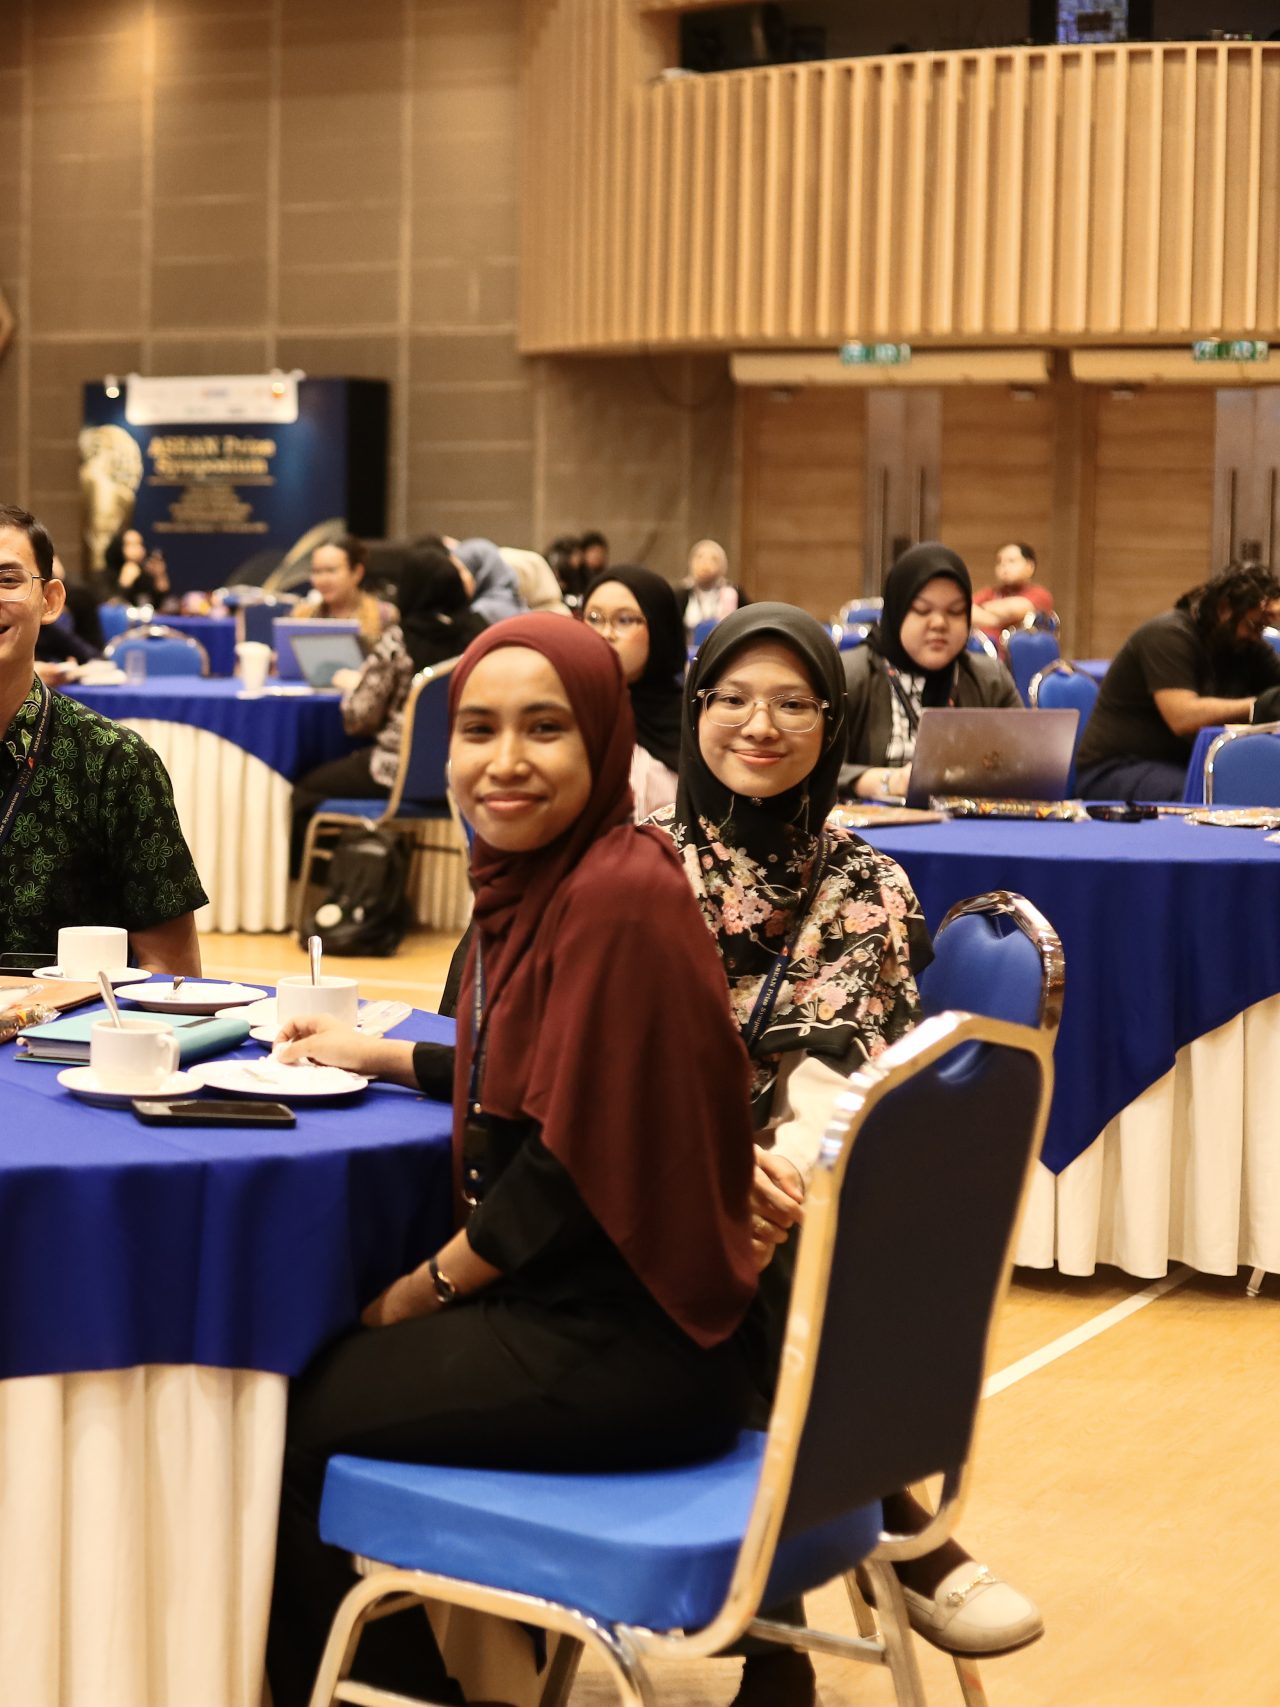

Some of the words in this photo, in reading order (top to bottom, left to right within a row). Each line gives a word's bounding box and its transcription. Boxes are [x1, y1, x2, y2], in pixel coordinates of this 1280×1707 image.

[2, 791, 19, 824] Symposium
[770, 962, 782, 988] ASEAN
[763, 988, 774, 1006] Prize
[750, 1006, 767, 1040] Symposi
